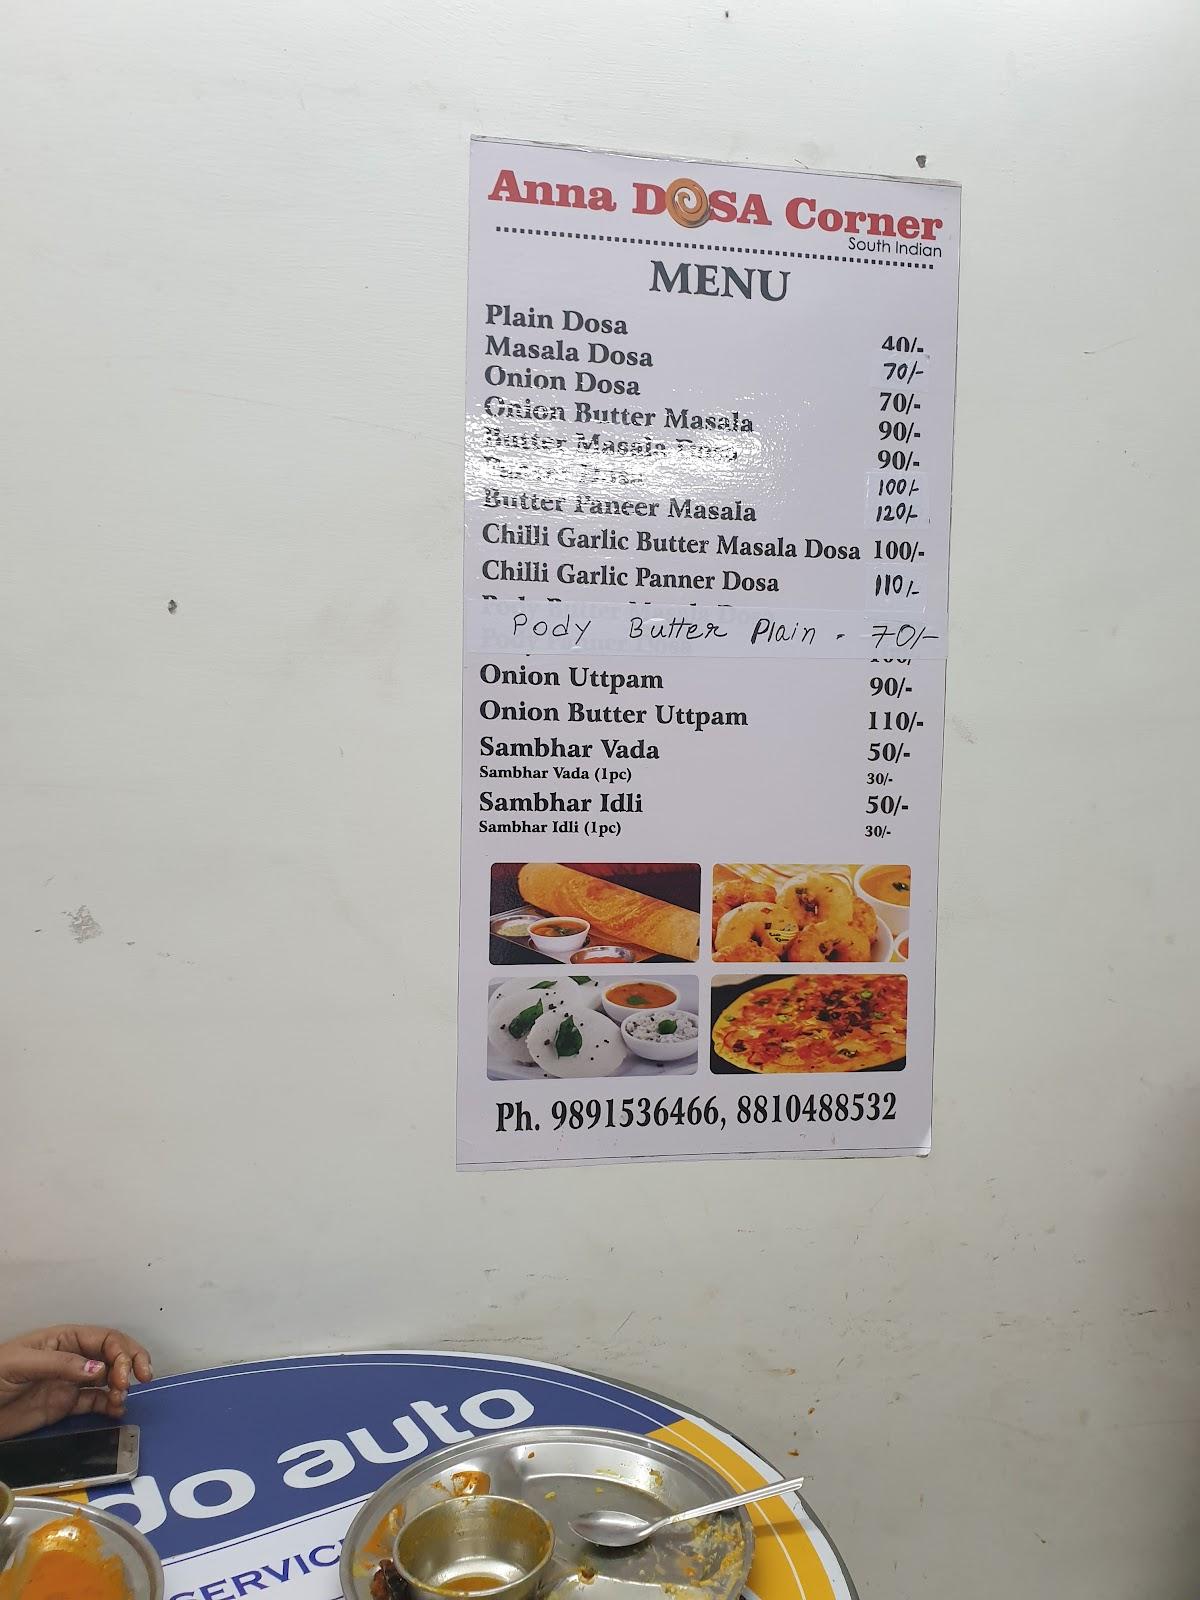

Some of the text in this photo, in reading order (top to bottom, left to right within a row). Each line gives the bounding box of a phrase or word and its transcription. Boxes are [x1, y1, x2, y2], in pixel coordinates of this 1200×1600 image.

[488, 168, 944, 241] Anna DOSA Corner
[847, 235, 943, 260] South Indian
[648, 259, 792, 302] MENU
[484, 303, 630, 336] Plain Dosa
[484, 334, 655, 369] Masala Dosa
[880, 335, 926, 353] 40/-
[483, 364, 642, 397] Onion Dosa
[882, 360, 925, 385] 70/-
[483, 395, 755, 434] Onion Butter Masala
[879, 391, 922, 416] 70/-
[878, 420, 922, 445] 90/-
[877, 449, 921, 472] 90/-
[878, 478, 920, 497] 100/-
[483, 488, 758, 523] Butter Paneer Masala
[875, 502, 919, 525] 120/-
[480, 522, 926, 563] Chilli Garlic Butter Masala Dosa 100/-
[480, 559, 780, 594] Chilli Garlic Panner Dosa
[874, 573, 921, 598] 110/-
[511, 612, 592, 645] Pody
[628, 615, 729, 640] Butter
[749, 617, 816, 646] Plain
[870, 623, 941, 651] 70/-
[478, 662, 665, 694] Onion Uttpam
[868, 675, 914, 700] 90/-
[478, 699, 749, 733] Onion Butter Uttpam
[867, 710, 925, 734] 110/-
[478, 736, 661, 761] Sambhar Vada
[866, 741, 912, 765] 50/-
[478, 764, 634, 784] Sambhar Vada (1pc)
[865, 771, 895, 787] 30/-
[478, 790, 645, 815] Sambhar Idli
[864, 795, 910, 817] 50/-
[478, 818, 623, 838] Sambhar Idli (1pc)
[863, 824, 893, 840] 30/-
[494, 1091, 899, 1133] Ph. 9891536466, 8810488532
[276, 1388, 535, 1489] auto
[168, 1538, 346, 1600] ERVIC
